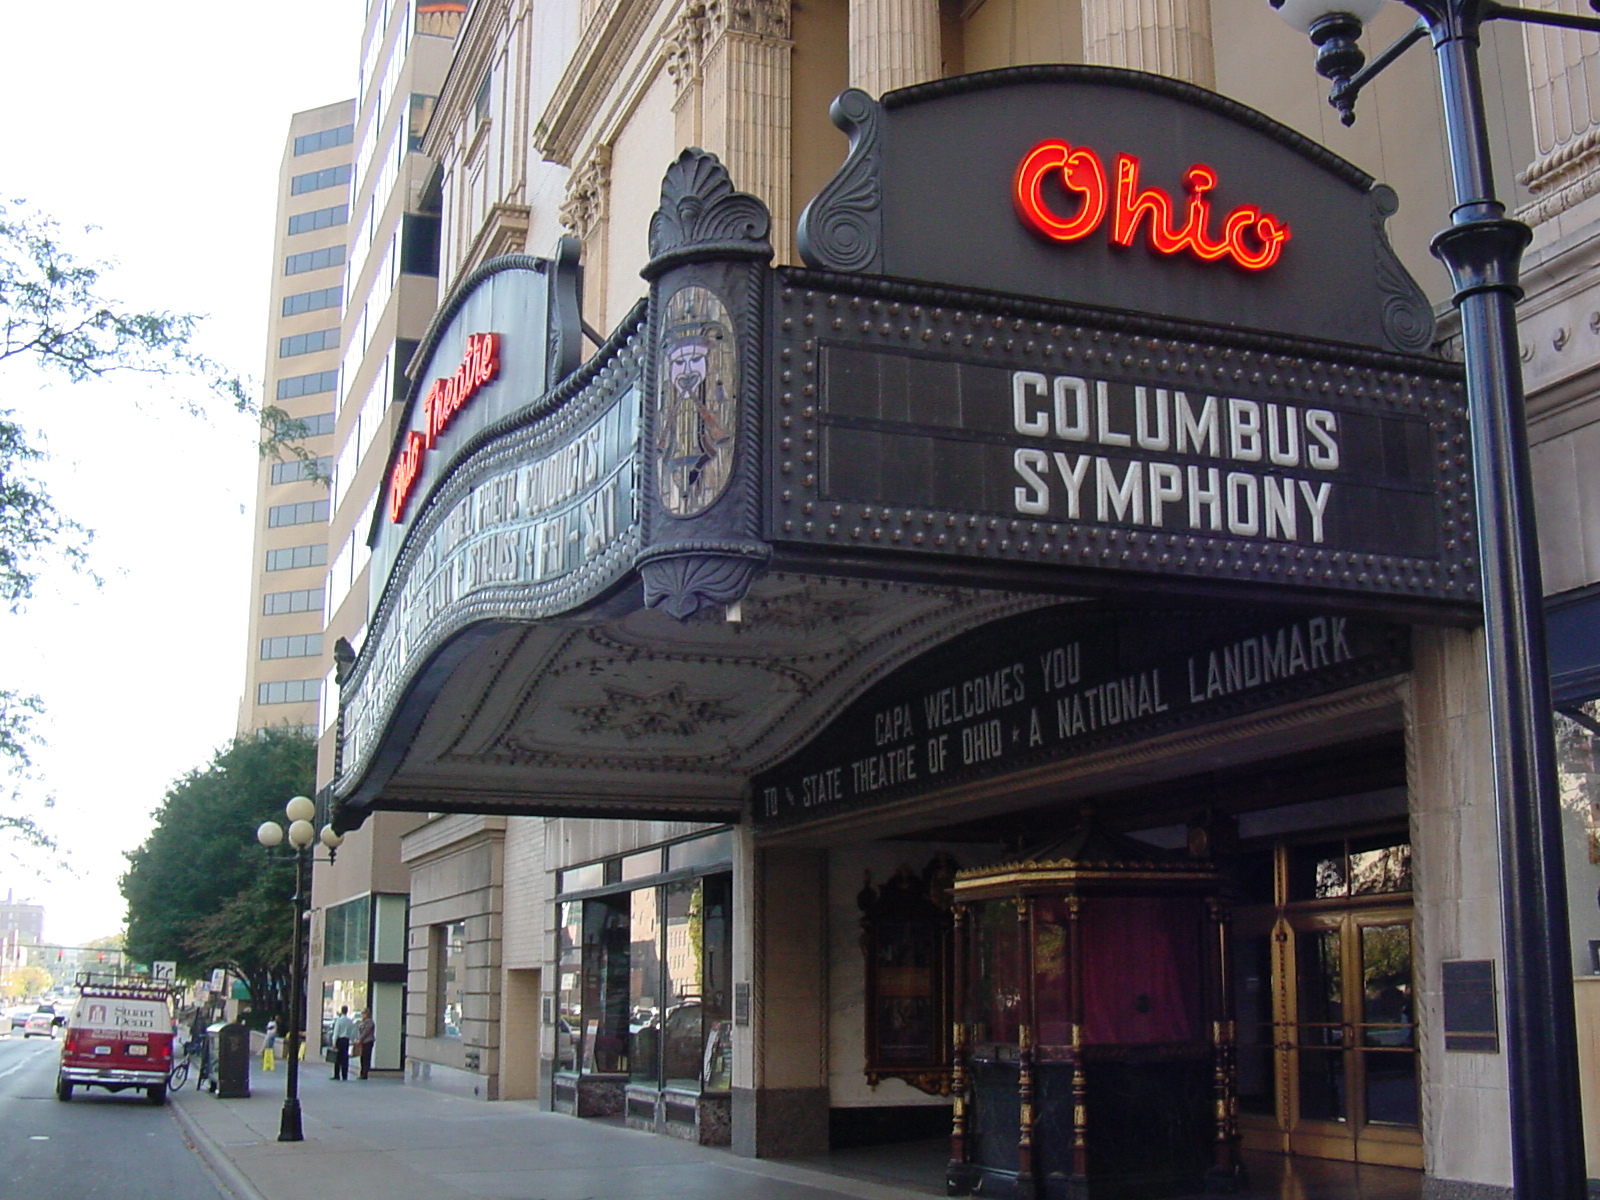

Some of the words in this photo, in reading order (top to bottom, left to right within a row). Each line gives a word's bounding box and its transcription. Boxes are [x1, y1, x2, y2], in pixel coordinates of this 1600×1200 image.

[1015, 139, 1292, 273] Ohio
[389, 431, 425, 524] Ohio
[424, 333, 501, 449] Theatre
[1012, 370, 1341, 471] COLUMBUS
[1013, 447, 1334, 543] SYMPHONY
[763, 786, 779, 817] TO
[802, 767, 843, 808] STATE
[852, 749, 917, 794] THEATRE
[927, 736, 948, 775] OF
[963, 719, 1002, 767] OHIO
[1028, 706, 1043, 747] A
[1057, 668, 1169, 740] NATIONAL
[1187, 615, 1352, 703] LANDMARK
[874, 706, 913, 747] CAPA
[924, 663, 1026, 730] WELCOMES
[1039, 642, 1082, 693] YOU
